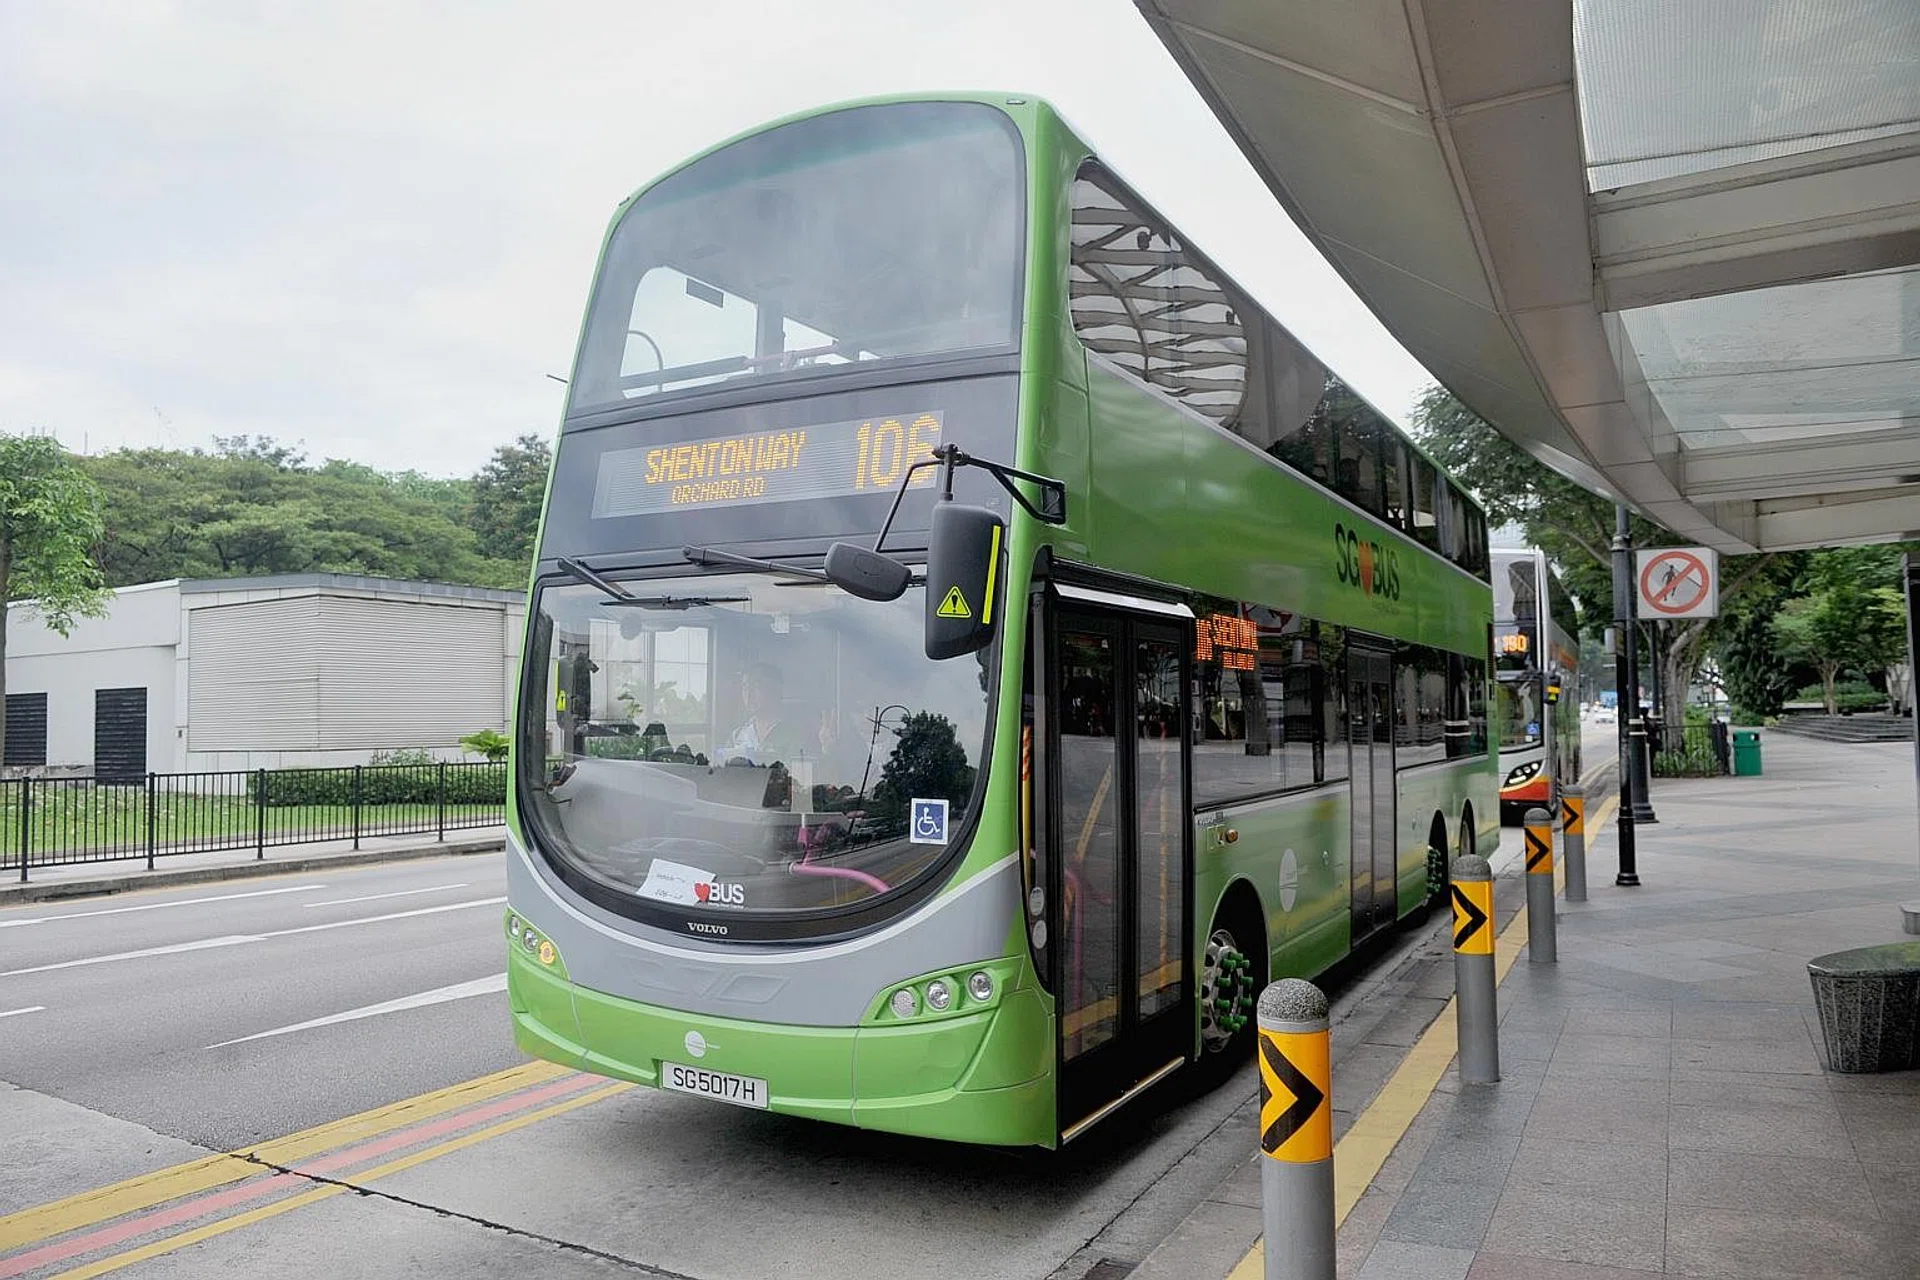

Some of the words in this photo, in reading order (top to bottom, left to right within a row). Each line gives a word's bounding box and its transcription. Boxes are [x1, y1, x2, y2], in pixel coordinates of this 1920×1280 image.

[645, 438, 754, 483] SHENTON
[755, 431, 807, 471] WAY
[856, 414, 940, 489] 106
[672, 480, 740, 504] ORCHARD
[742, 476, 766, 499] RD
[1335, 523, 1361, 588] SG
[1371, 542, 1400, 601] BUS
[709, 882, 744, 904] BUS
[687, 922, 728, 935] VOLVO
[673, 1067, 755, 1101] SG5017H
